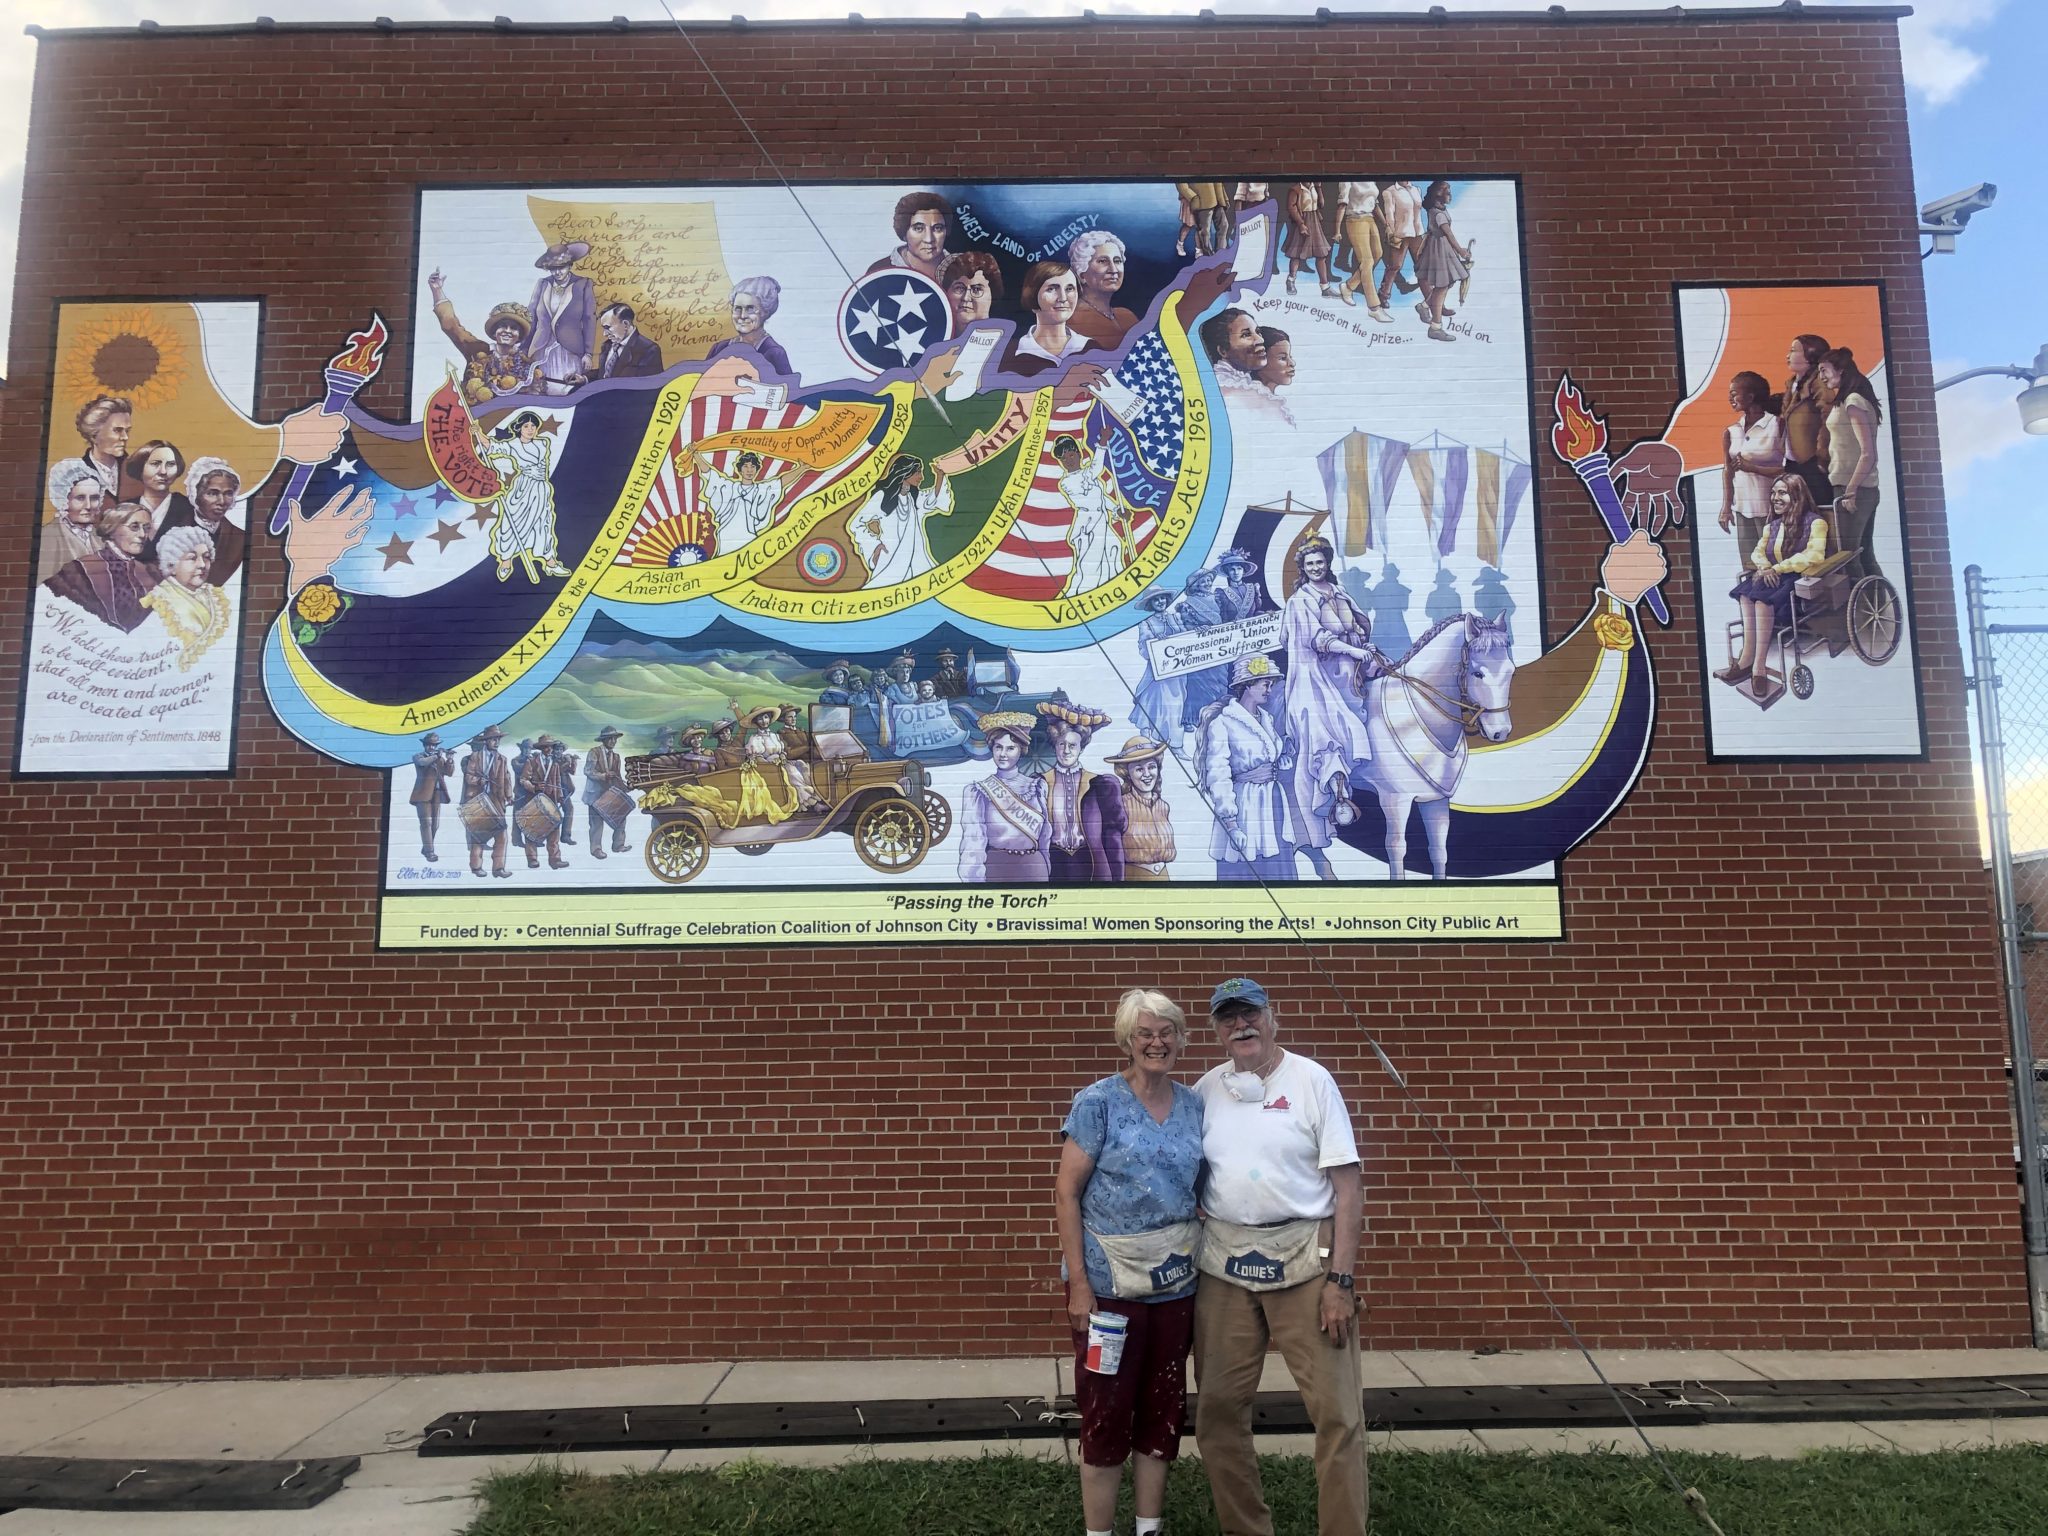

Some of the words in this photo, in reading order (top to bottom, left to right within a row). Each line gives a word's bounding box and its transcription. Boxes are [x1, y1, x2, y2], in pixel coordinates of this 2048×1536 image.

[652, 226, 694, 240] and
[956, 204, 989, 242] SWEET
[992, 232, 1025, 258] LAND
[1027, 250, 1042, 263] OF
[1043, 213, 1100, 256] LIBERTY
[1240, 221, 1262, 236] BALLOT
[636, 243, 667, 258] for
[648, 270, 698, 292] forget
[707, 269, 720, 282] to
[650, 283, 711, 308] good
[1253, 298, 1282, 313] Keep
[1284, 300, 1308, 313] your
[1310, 307, 1336, 323] eyes
[1336, 318, 1349, 329] on
[1352, 323, 1368, 338] the
[1447, 317, 1472, 337] hold
[1475, 333, 1493, 344] on
[671, 334, 722, 346] Mama
[969, 335, 994, 346] BALLOT
[893, 403, 910, 435] 1952
[1121, 396, 1144, 420] BALLOT
[1189, 398, 1204, 442] 1965
[453, 417, 465, 442] The
[730, 435, 782, 452] Equality
[783, 433, 794, 449] of
[796, 407, 856, 448] Opportunity
[810, 447, 827, 463] for
[828, 414, 868, 451] Women
[964, 397, 1029, 464] UNITY
[432, 403, 452, 453] THE
[444, 451, 493, 496] VOTE
[456, 445, 479, 474] right
[482, 470, 493, 482] to
[1097, 427, 1167, 507] JUSTICE
[739, 589, 803, 615] Indian
[811, 585, 922, 616] Citizenship
[928, 567, 957, 590] Act
[996, 492, 1020, 528] Utah
[1034, 391, 1051, 418] 1957
[1177, 469, 1203, 514] Act
[400, 665, 510, 726] Amendment
[511, 623, 554, 664] XIX
[557, 600, 575, 617] of
[568, 577, 588, 598] the
[584, 544, 611, 572] U.S.
[606, 439, 666, 539] Constitution
[664, 391, 682, 426] 1920
[1124, 516, 1186, 588] Rights
[616, 577, 701, 596] American
[636, 571, 684, 584] Asian
[1034, 584, 1128, 624] Voting
[1246, 614, 1281, 628] BRANCH
[40, 643, 55, 655] to
[57, 645, 73, 661] be
[71, 631, 102, 653] hold
[99, 646, 134, 663] these
[138, 641, 180, 662] truths
[1164, 633, 1233, 658] Congressional
[1173, 652, 1213, 669] Woman
[1218, 637, 1271, 658] Suffrage
[33, 660, 69, 677] that
[66, 675, 90, 690] all
[87, 684, 119, 698] men
[124, 684, 154, 699] and
[159, 672, 215, 698] women
[47, 690, 77, 705] are
[79, 700, 143, 719] created
[69, 730, 124, 743] Declaration
[126, 729, 139, 746] of
[199, 730, 221, 743] 1848
[912, 720, 928, 731] for
[886, 895, 962, 913] "Passing
[967, 895, 994, 908] the
[1000, 893, 1058, 909] Torch"
[420, 925, 479, 939] Funded
[483, 925, 508, 941] by:
[526, 923, 610, 937] Centennial
[615, 922, 682, 939] Suffrage
[687, 921, 776, 936] Celebration
[781, 920, 851, 935] Coalition
[855, 919, 872, 934] of
[875, 918, 943, 933] Johnson
[947, 918, 979, 935] City
[996, 917, 1087, 932] Bravissima!
[1092, 916, 1150, 931] Women
[1154, 916, 1244, 933] Sponsoring
[1249, 917, 1274, 930] the
[1278, 916, 1315, 930] Arts!
[1334, 916, 1401, 930] Johnson
[1406, 915, 1437, 932] City
[1442, 915, 1491, 930] Public
[1496, 915, 1519, 929] Art
[1233, 1261, 1276, 1279] LOWE'S
